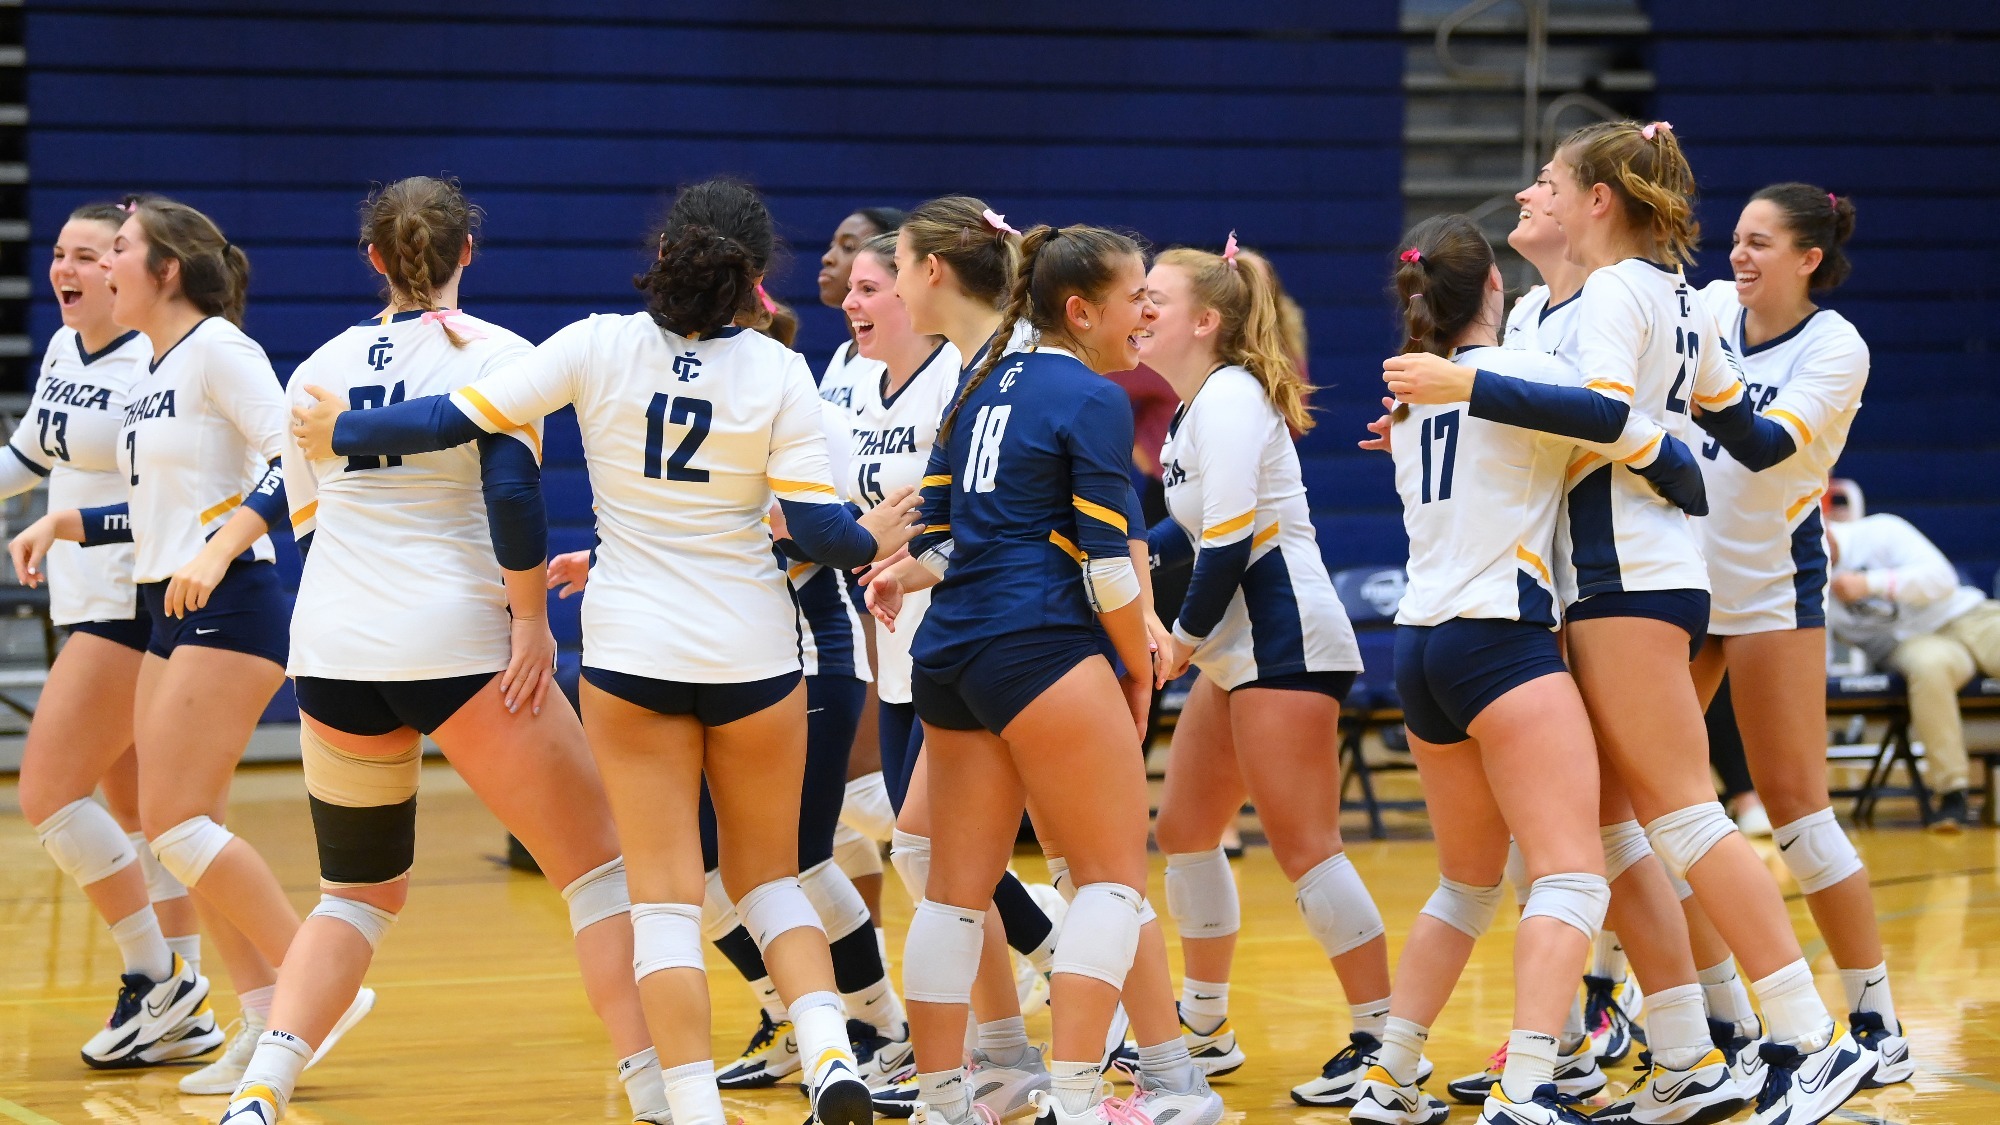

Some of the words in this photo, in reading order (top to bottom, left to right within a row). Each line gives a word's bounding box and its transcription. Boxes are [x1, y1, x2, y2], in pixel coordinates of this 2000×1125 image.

[37, 408, 71, 462] 23
[644, 391, 713, 483] 12
[962, 404, 1012, 494] 18
[1420, 408, 1460, 505] 17
[857, 462, 886, 510] 15
[272, 1029, 295, 1042] BYE
